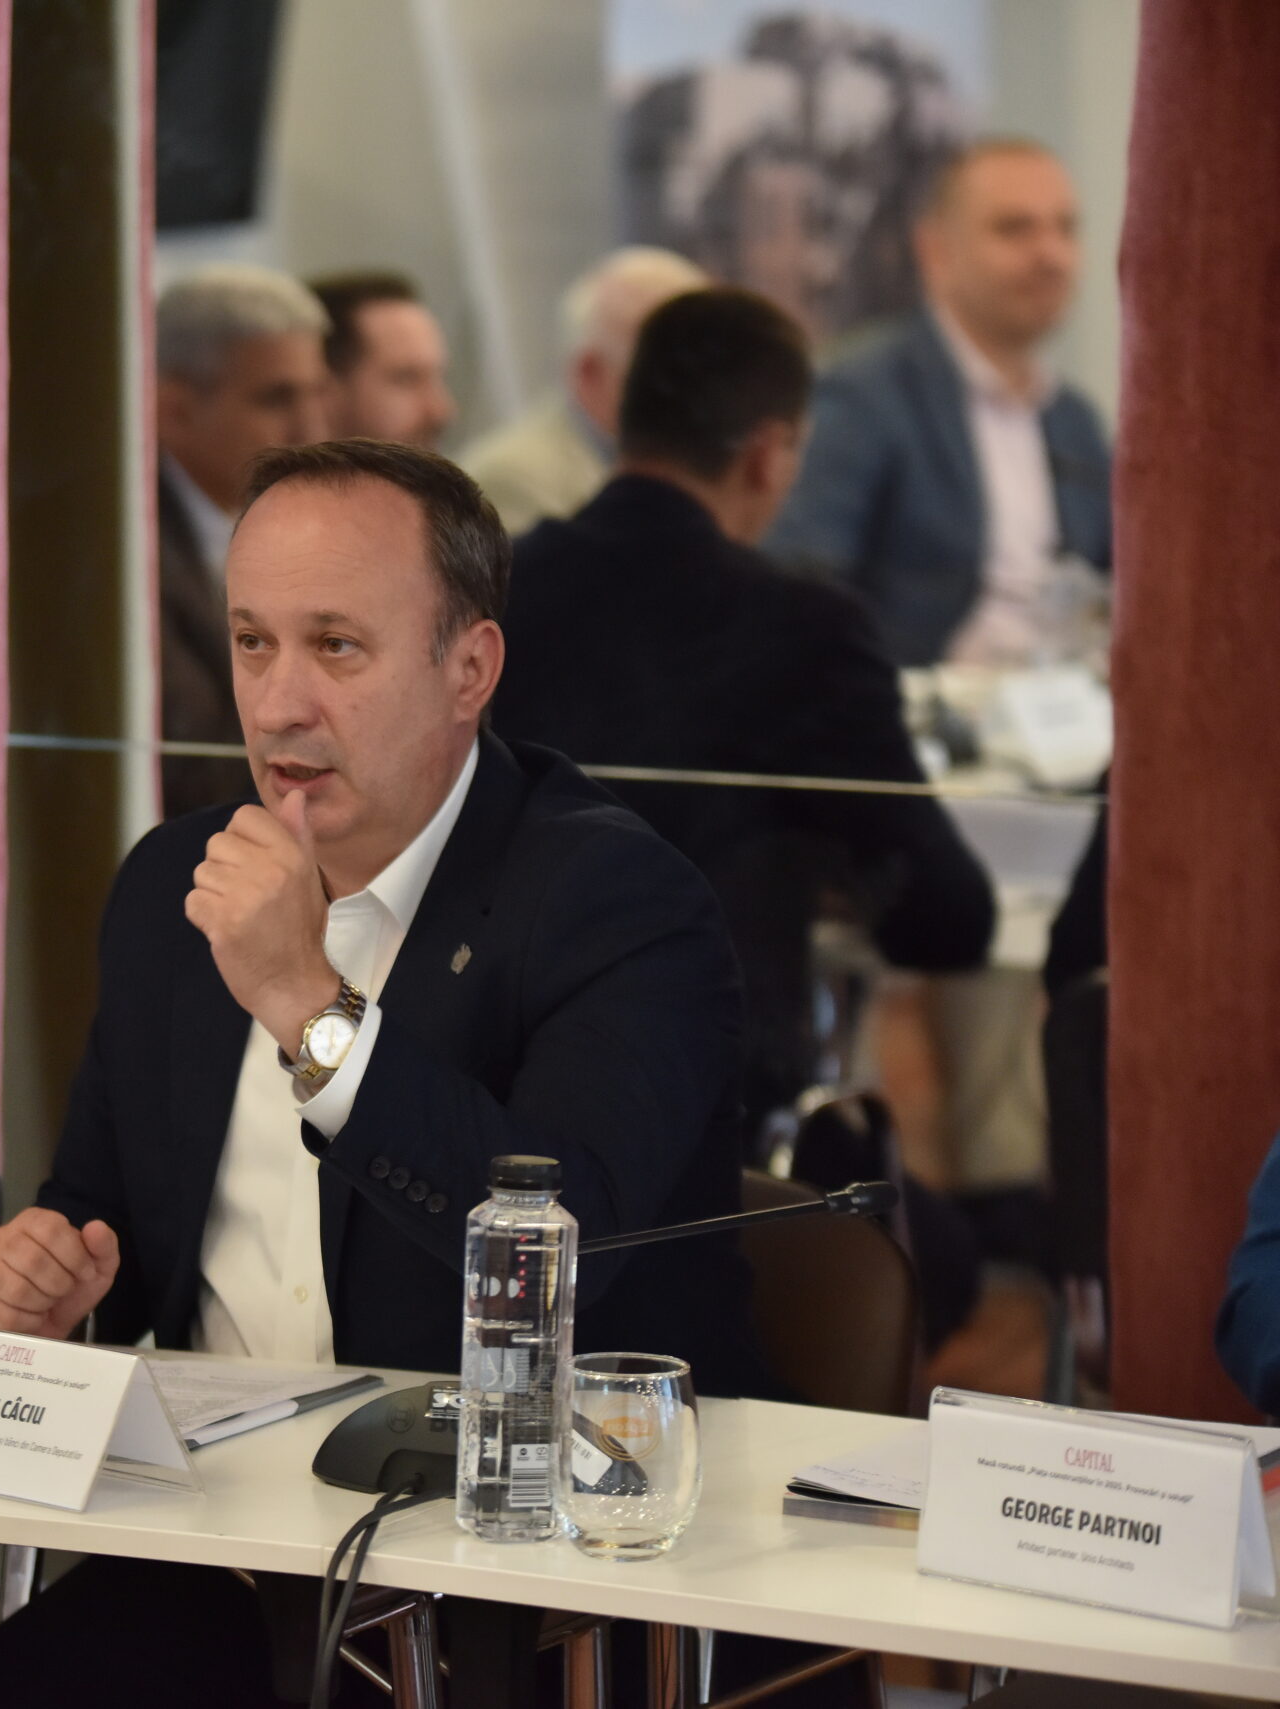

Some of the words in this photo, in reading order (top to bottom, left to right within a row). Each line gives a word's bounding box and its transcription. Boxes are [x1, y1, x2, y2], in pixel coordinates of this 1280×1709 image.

[0, 1396, 47, 1425] CÂCIU
[1064, 1446, 1115, 1473] CAPITAL
[1001, 1496, 1075, 1529] GEORGE
[1078, 1510, 1162, 1546] PARTNOI
